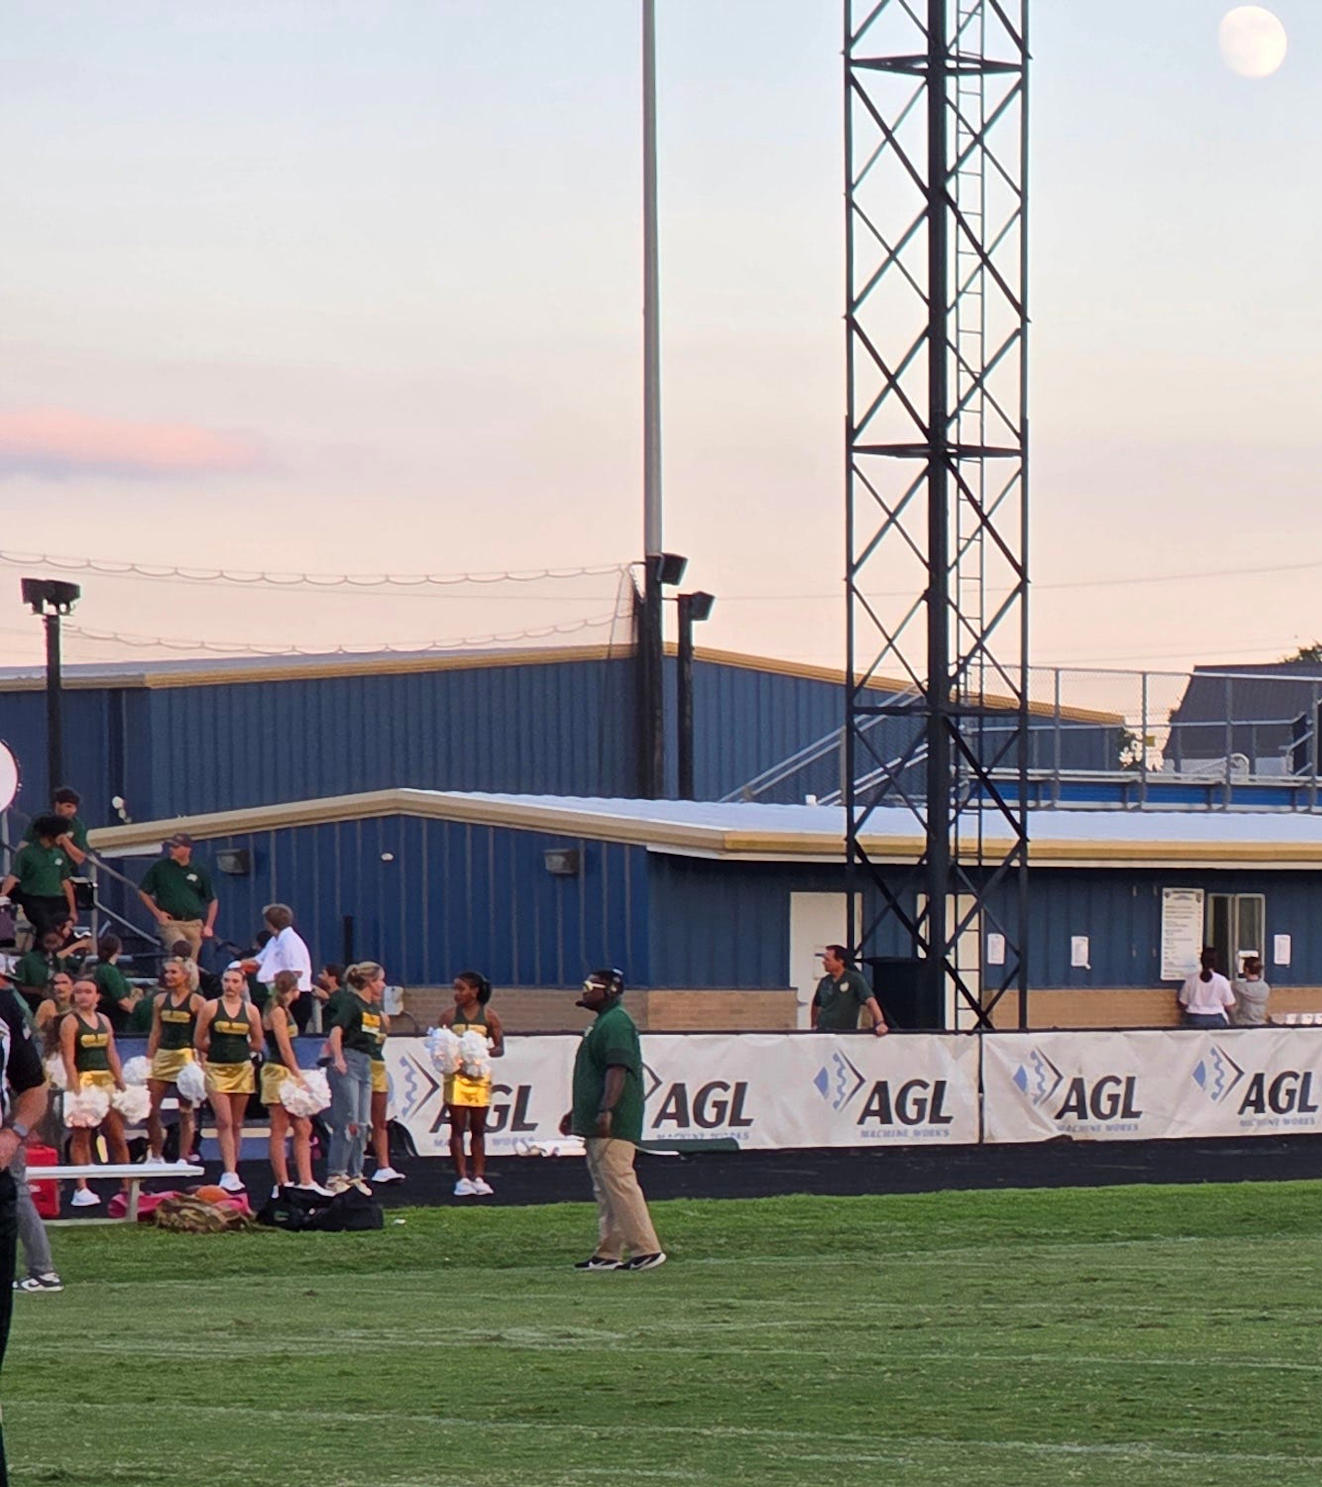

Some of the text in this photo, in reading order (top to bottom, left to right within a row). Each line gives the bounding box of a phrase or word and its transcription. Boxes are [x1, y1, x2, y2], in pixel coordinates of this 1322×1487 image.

[429, 1084, 539, 1133] GL
[651, 1081, 754, 1129] AGL
[857, 1079, 954, 1126] AGL
[1054, 1075, 1143, 1121] AGL
[1237, 1071, 1319, 1115] AGL
